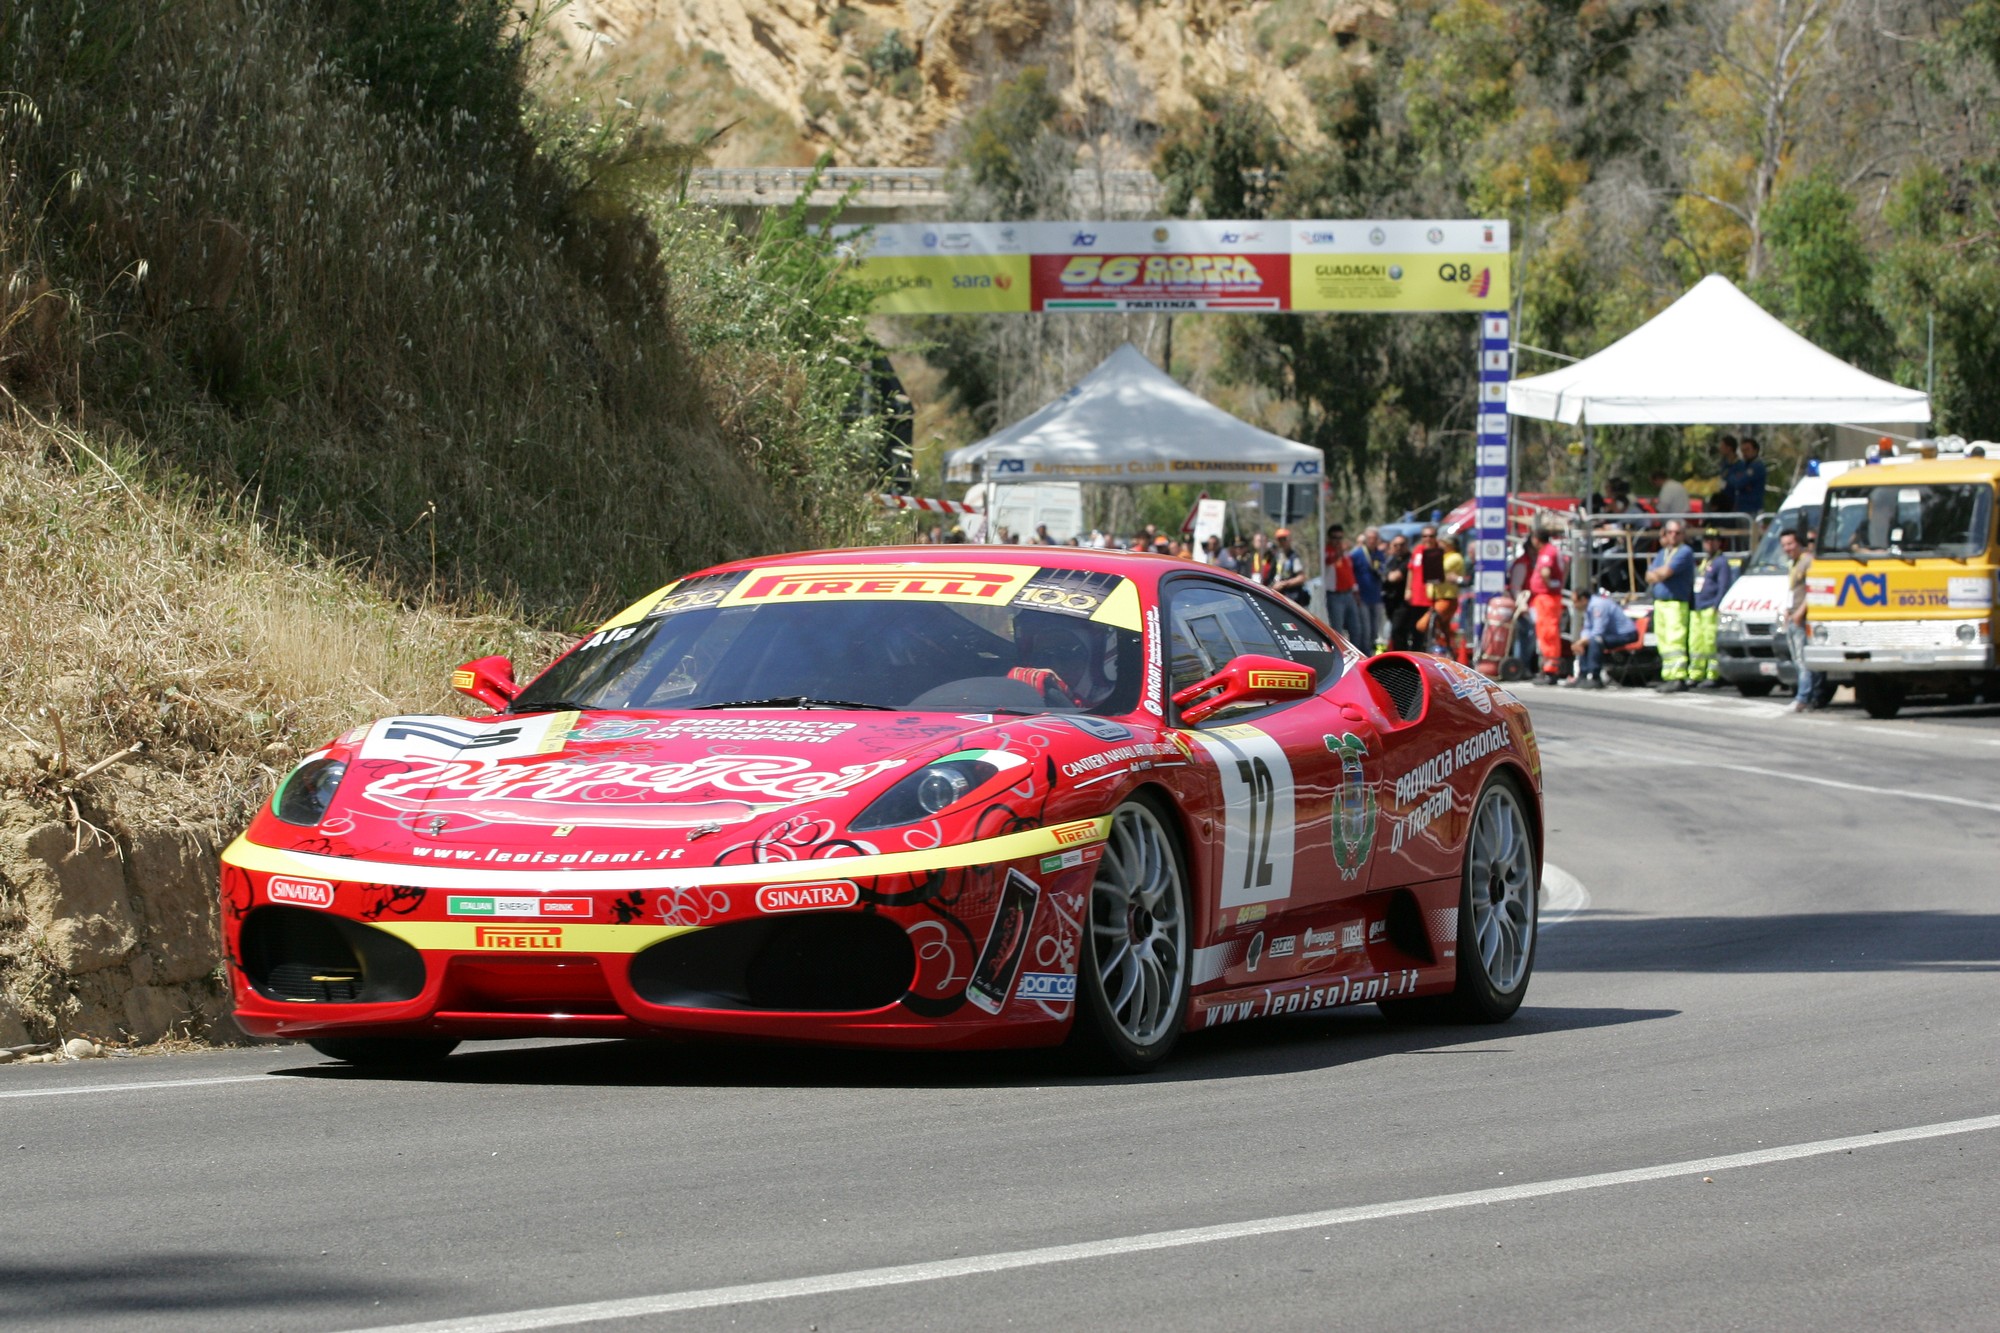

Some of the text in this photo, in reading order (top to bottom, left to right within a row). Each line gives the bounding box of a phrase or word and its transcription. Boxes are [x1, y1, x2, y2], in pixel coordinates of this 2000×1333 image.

[1145, 255, 1257, 271] COPPA
[1315, 264, 1386, 276] GUADAGNI
[1438, 263, 1472, 283] Q8
[952, 273, 991, 289] sara
[1125, 301, 1197, 309] PARTENZA
[998, 459, 1025, 473] ACI
[1292, 460, 1319, 475] ACI
[740, 571, 1015, 599] PIRELLI
[1836, 573, 1888, 607] ACI
[1020, 587, 1098, 610] 100
[1252, 673, 1307, 688] PIRELLI
[656, 725, 846, 737] REGIONALE
[669, 718, 858, 731] PROVINCIA
[643, 732, 833, 744] DI TRAPANI
[1061, 752, 1108, 778] CANTIERI
[1395, 748, 1453, 811] PROVINCIA
[1455, 721, 1511, 771] REGIONALE
[1390, 785, 1453, 854] DI TRAPANI
[1051, 821, 1100, 845] PIRELLI
[412, 846, 686, 864] www.leoisolani.it
[273, 881, 327, 902] SINATRA
[767, 886, 849, 907] SINATRA
[459, 902, 574, 912] ITALIAN ENERGY DRINK
[475, 925, 563, 949] PIRELLI
[1017, 975, 1076, 997] sparco
[1204, 968, 1420, 1028] www.leoisolani.it
